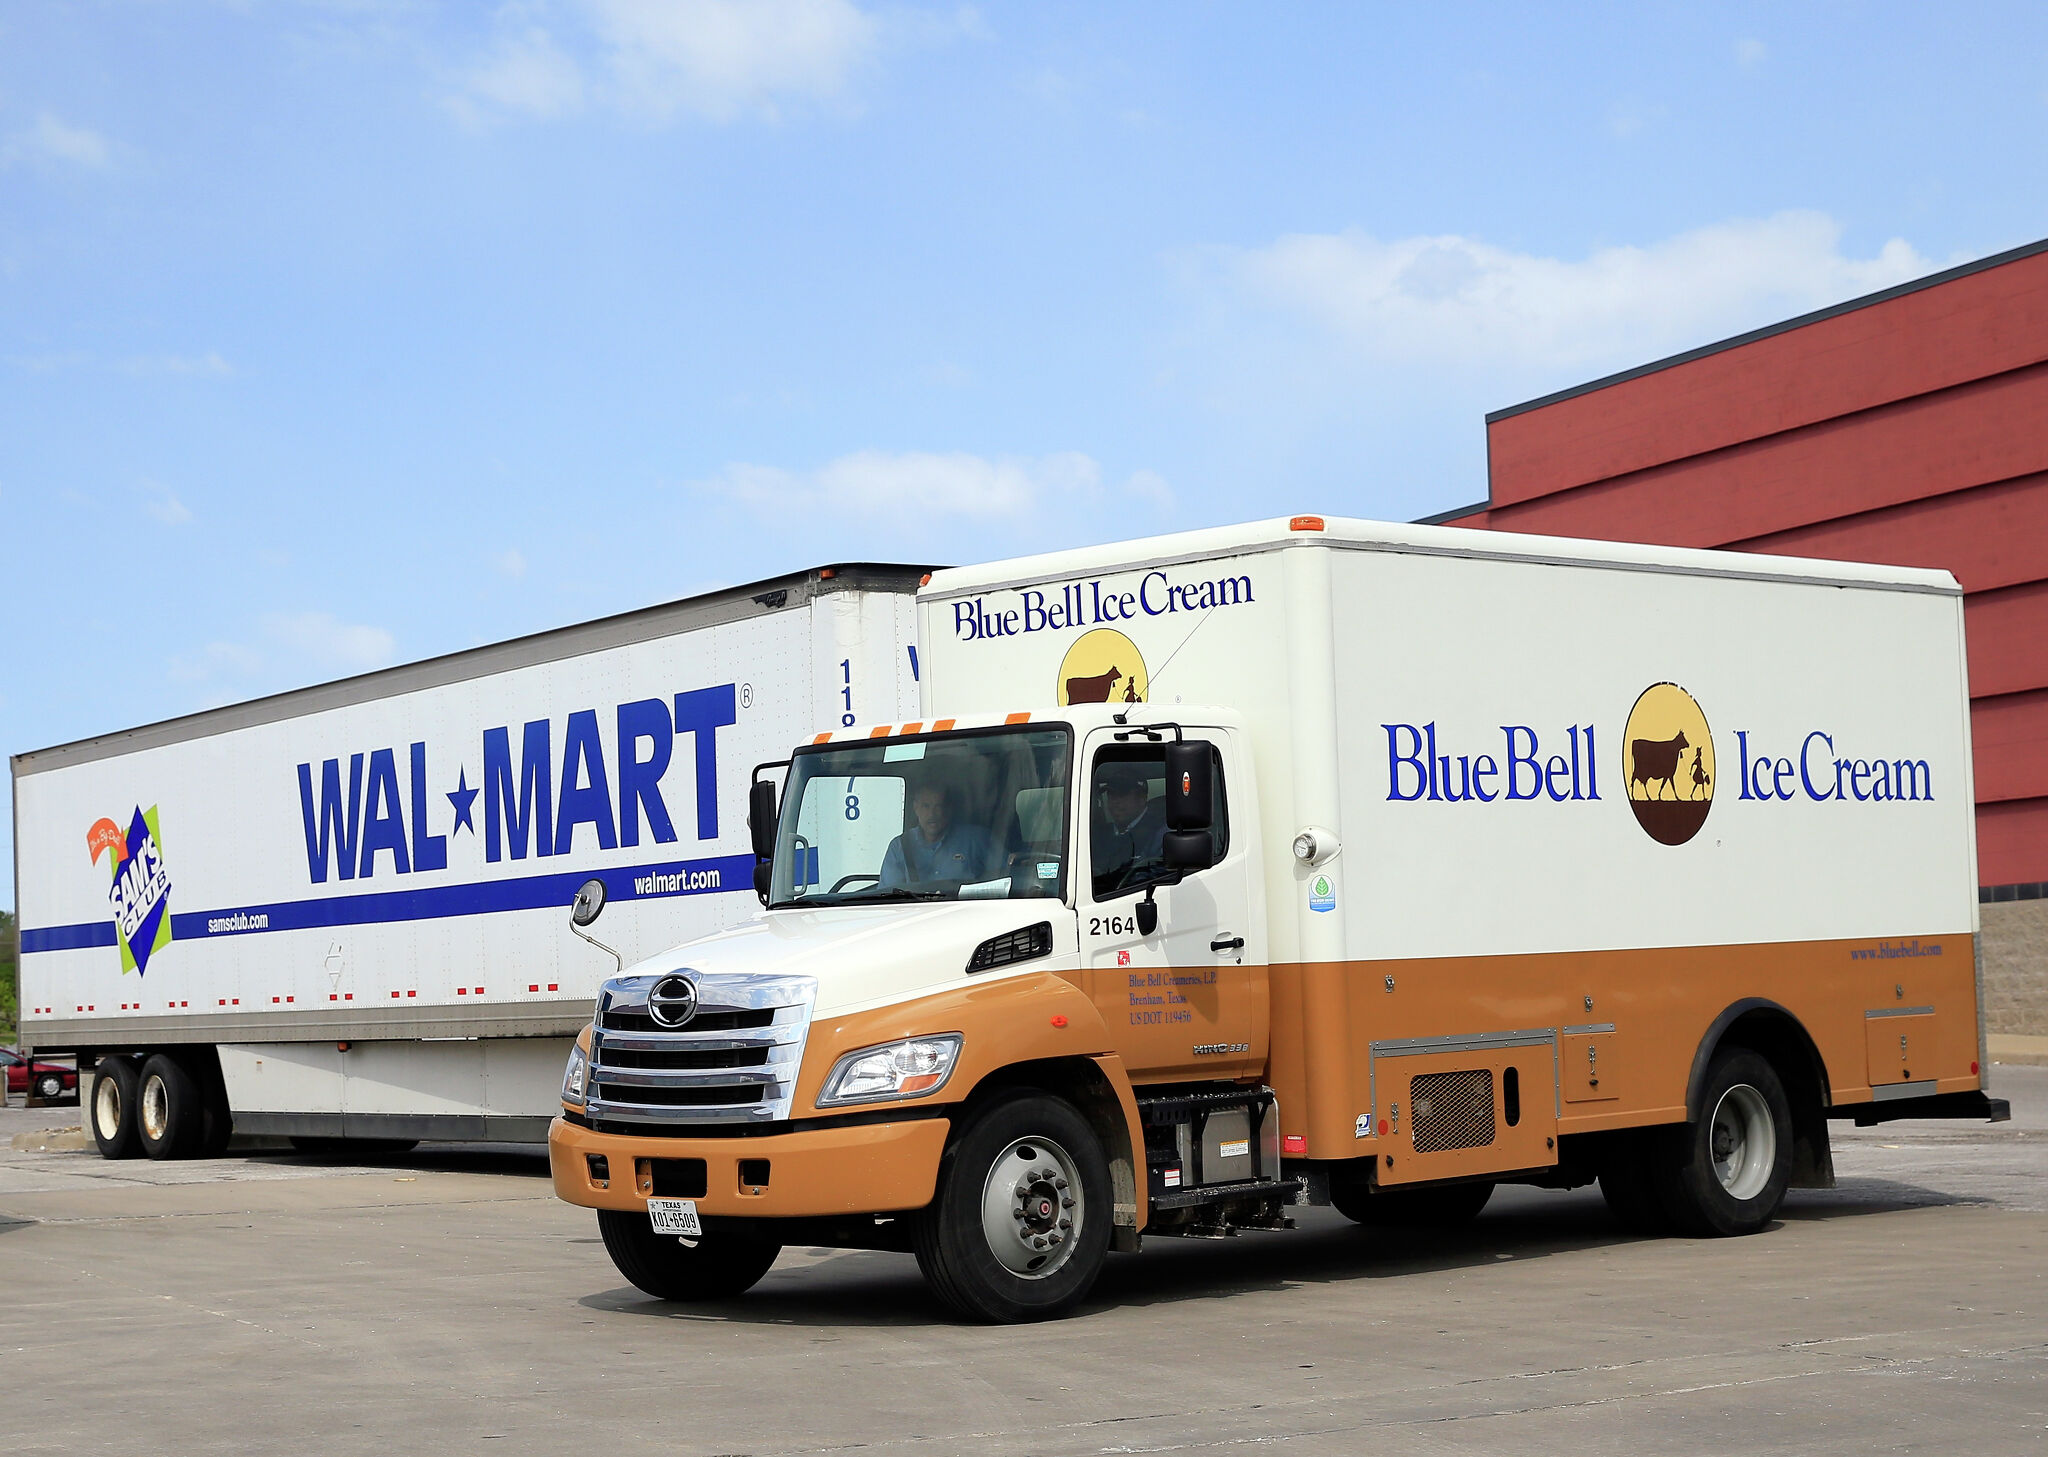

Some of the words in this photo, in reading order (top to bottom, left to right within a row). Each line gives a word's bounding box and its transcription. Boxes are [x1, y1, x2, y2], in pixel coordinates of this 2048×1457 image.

[951, 597, 1020, 641] Blue
[1020, 583, 1086, 633] Bell
[1088, 580, 1137, 624] Ice
[1140, 571, 1256, 616] Cream
[1380, 720, 1500, 803] Blue
[1499, 723, 1603, 802] Bell
[1732, 730, 1796, 801] Ice
[1800, 731, 1936, 802] Cream
[110, 832, 161, 926] SAM'S
[634, 869, 721, 895] walmart.com
[124, 870, 167, 937] CLUB
[207, 911, 269, 933] samsclub.com
[1089, 916, 1136, 936] 2164
[1850, 940, 1942, 961] www.bluebell.com
[1129, 974, 1145, 987] Blue
[1147, 973, 1161, 987] Bell
[1203, 970, 1217, 984] L.P.
[1167, 991, 1187, 1004] Texas
[1165, 1010, 1192, 1024] 119456
[1193, 1043, 1228, 1056] HINO
[661, 1201, 681, 1209] TEXAS
